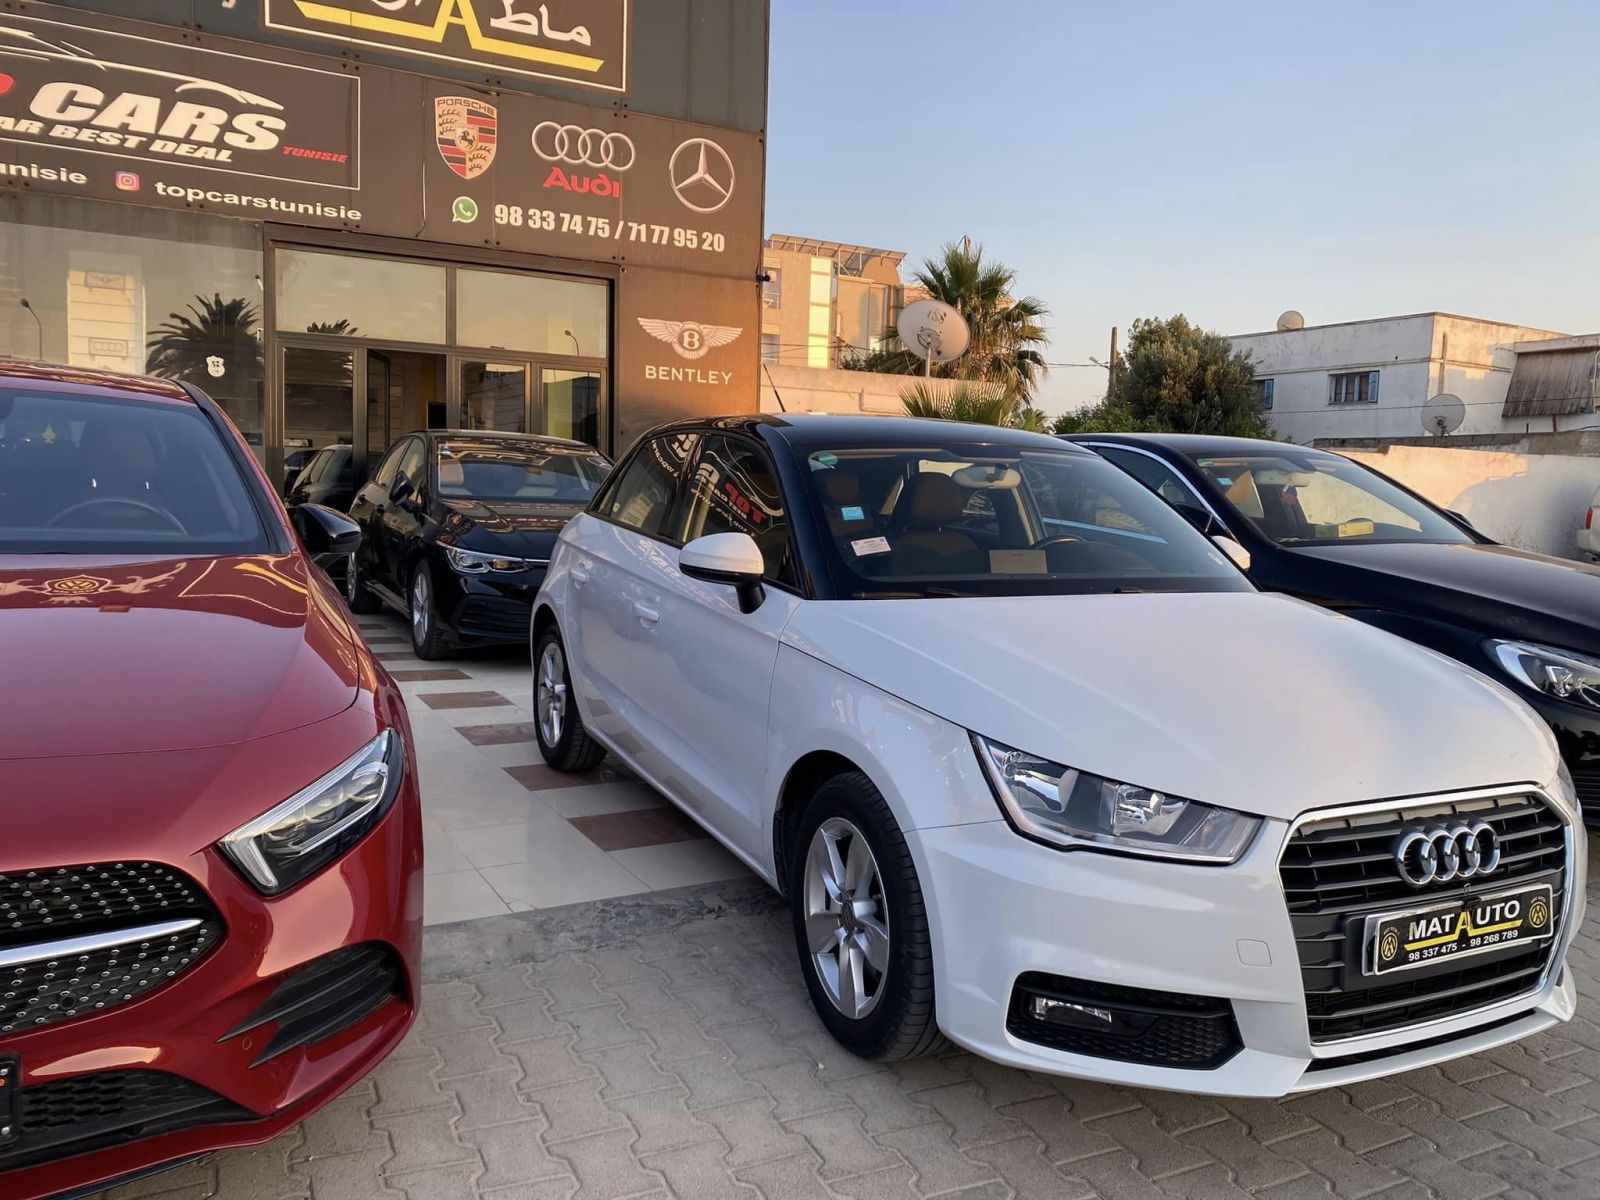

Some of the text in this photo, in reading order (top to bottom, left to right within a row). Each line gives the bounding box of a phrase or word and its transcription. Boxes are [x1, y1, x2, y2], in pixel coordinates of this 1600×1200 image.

[29, 81, 287, 151] CARS
[437, 98, 496, 116] PORSCHE
[48, 124, 147, 149] BEST
[149, 139, 233, 163] DEAL
[282, 146, 348, 163] TUNISIE
[543, 166, 620, 198] Audi
[154, 181, 362, 220] topcarstunisie
[494, 203, 725, 252] 98 33 74 75 / 71 77 95 20
[645, 364, 733, 385] BENTLEY
[1408, 952, 1420, 962] 98
[1422, 947, 1439, 959] 337
[1441, 943, 1457, 954] 475
[1470, 937, 1481, 947] 98
[1483, 934, 1500, 944] 268
[1502, 929, 1518, 940] 789
